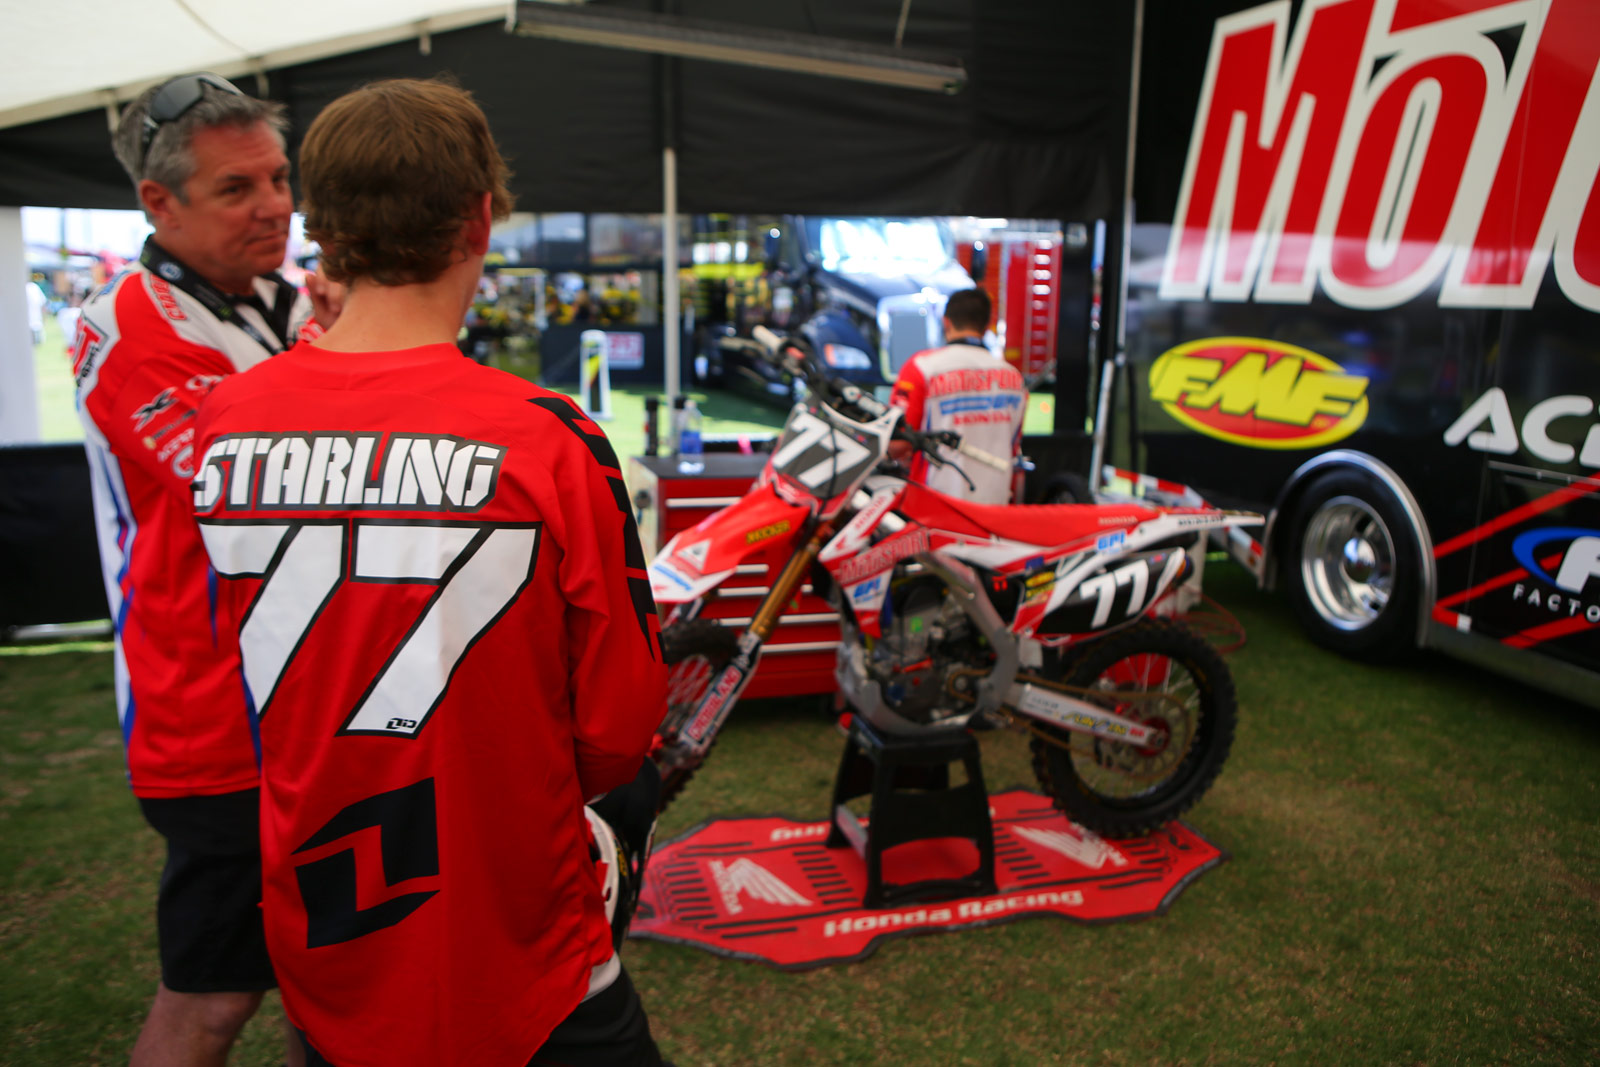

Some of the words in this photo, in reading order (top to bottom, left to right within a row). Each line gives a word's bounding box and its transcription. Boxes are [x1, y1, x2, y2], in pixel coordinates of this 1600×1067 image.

[1151, 352, 1370, 427] FMF
[193, 432, 507, 511] STARLING
[771, 412, 872, 489] 77
[197, 518, 542, 738] 77
[1080, 558, 1149, 629] 77
[823, 908, 953, 937] Honda
[958, 890, 1085, 918] Racing
